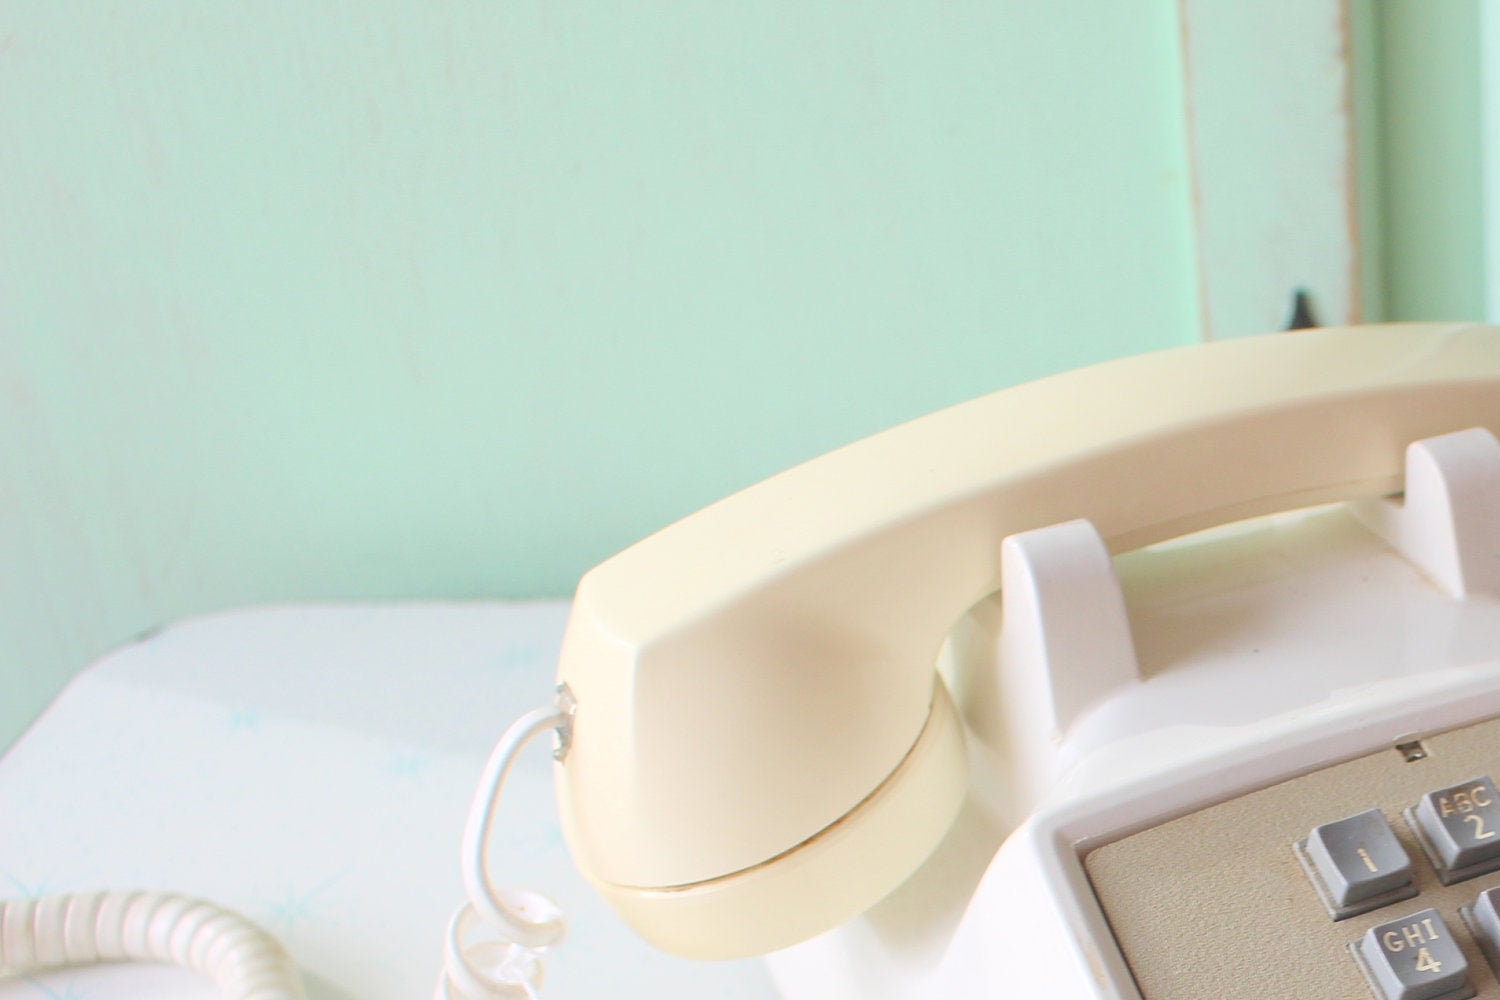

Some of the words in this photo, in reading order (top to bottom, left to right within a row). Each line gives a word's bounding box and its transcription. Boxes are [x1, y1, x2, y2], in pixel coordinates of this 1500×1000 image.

[1440, 786, 1493, 818] ABC
[1464, 815, 1494, 840] 2
[1356, 849, 1378, 872] 1
[1383, 918, 1439, 953] GHI
[1415, 947, 1442, 973] 4
